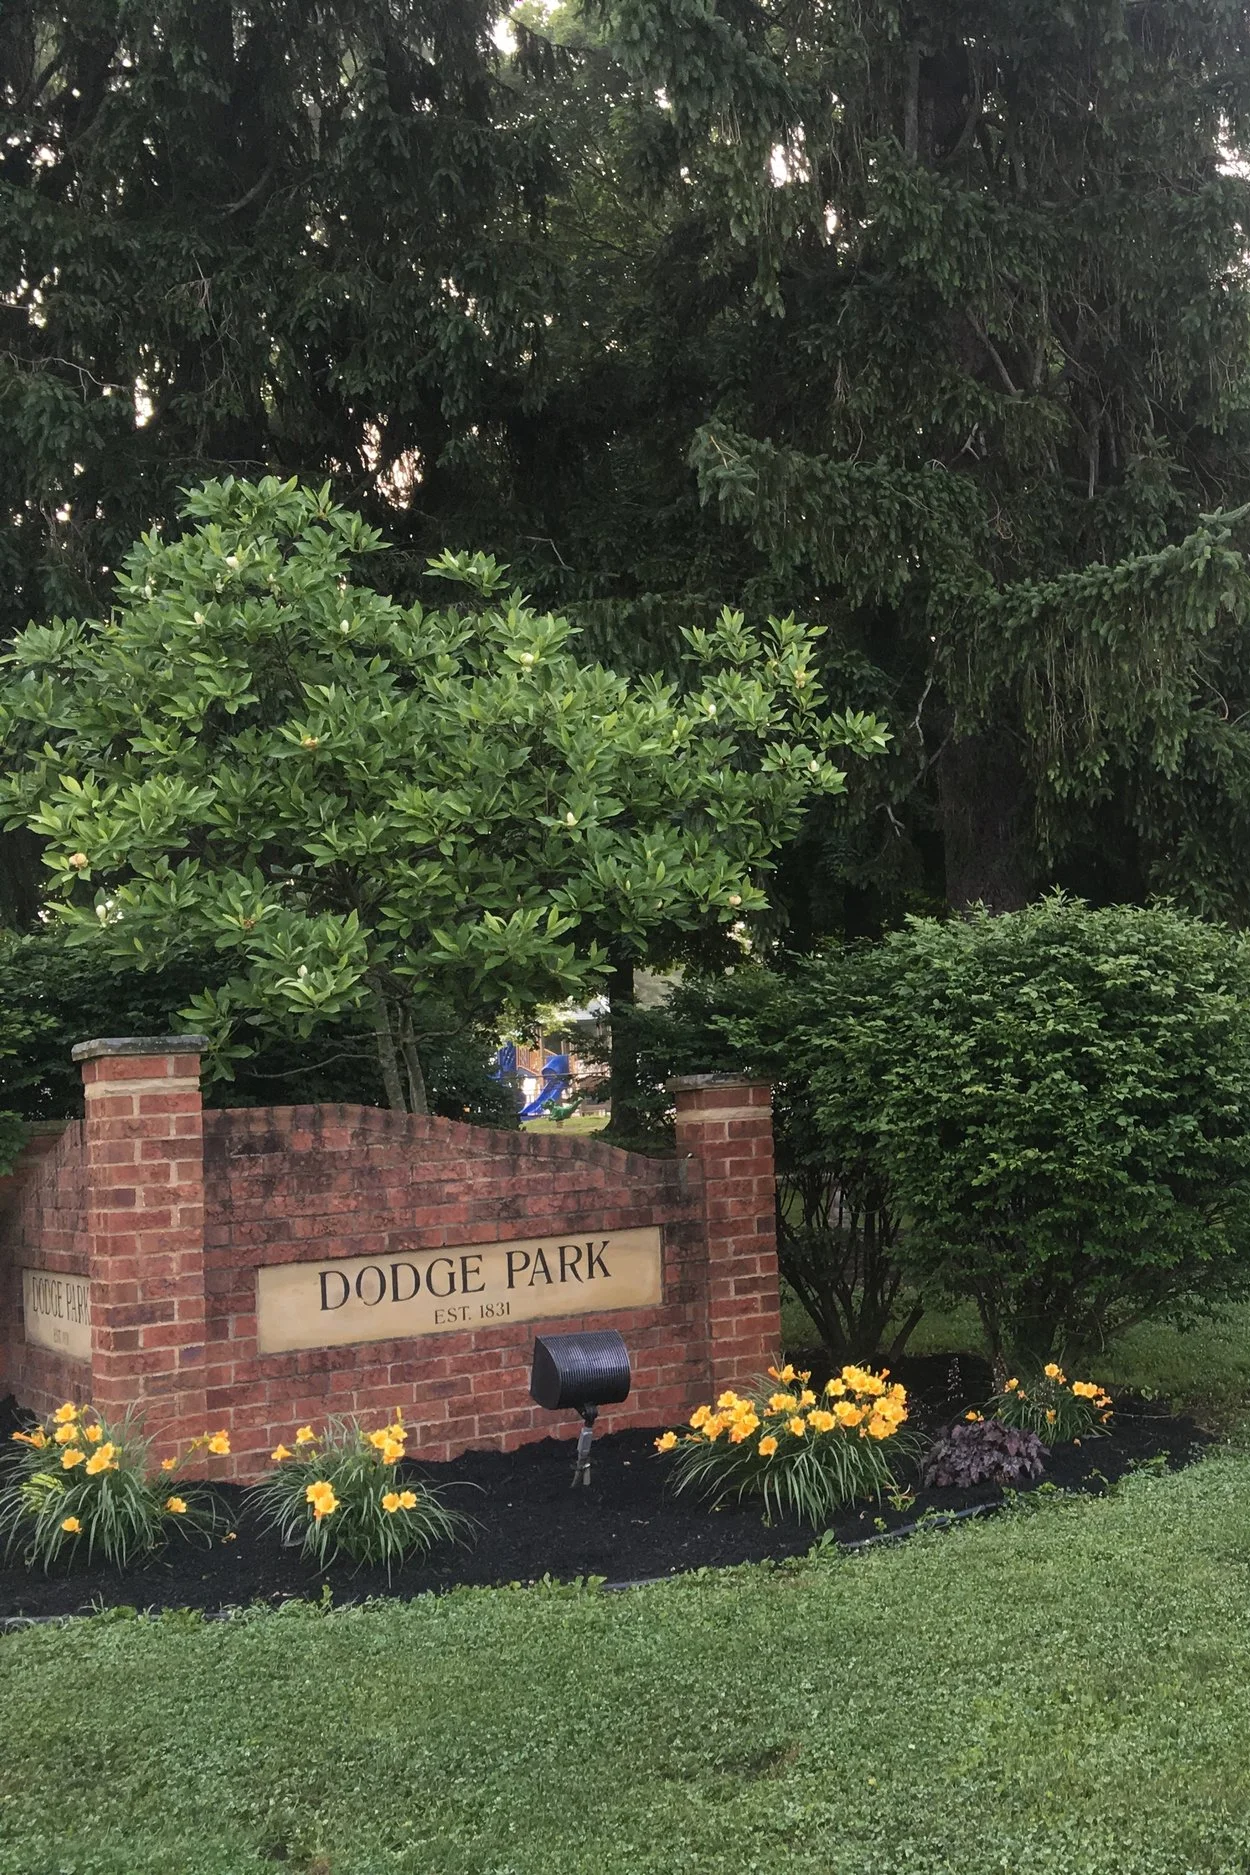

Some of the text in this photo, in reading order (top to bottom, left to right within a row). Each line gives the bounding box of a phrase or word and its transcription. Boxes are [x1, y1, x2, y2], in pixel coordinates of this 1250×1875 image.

[318, 1240, 612, 1311] DODGE PARK
[32, 1277, 63, 1318] DODGE
[434, 1302, 511, 1325] EST. 1831
